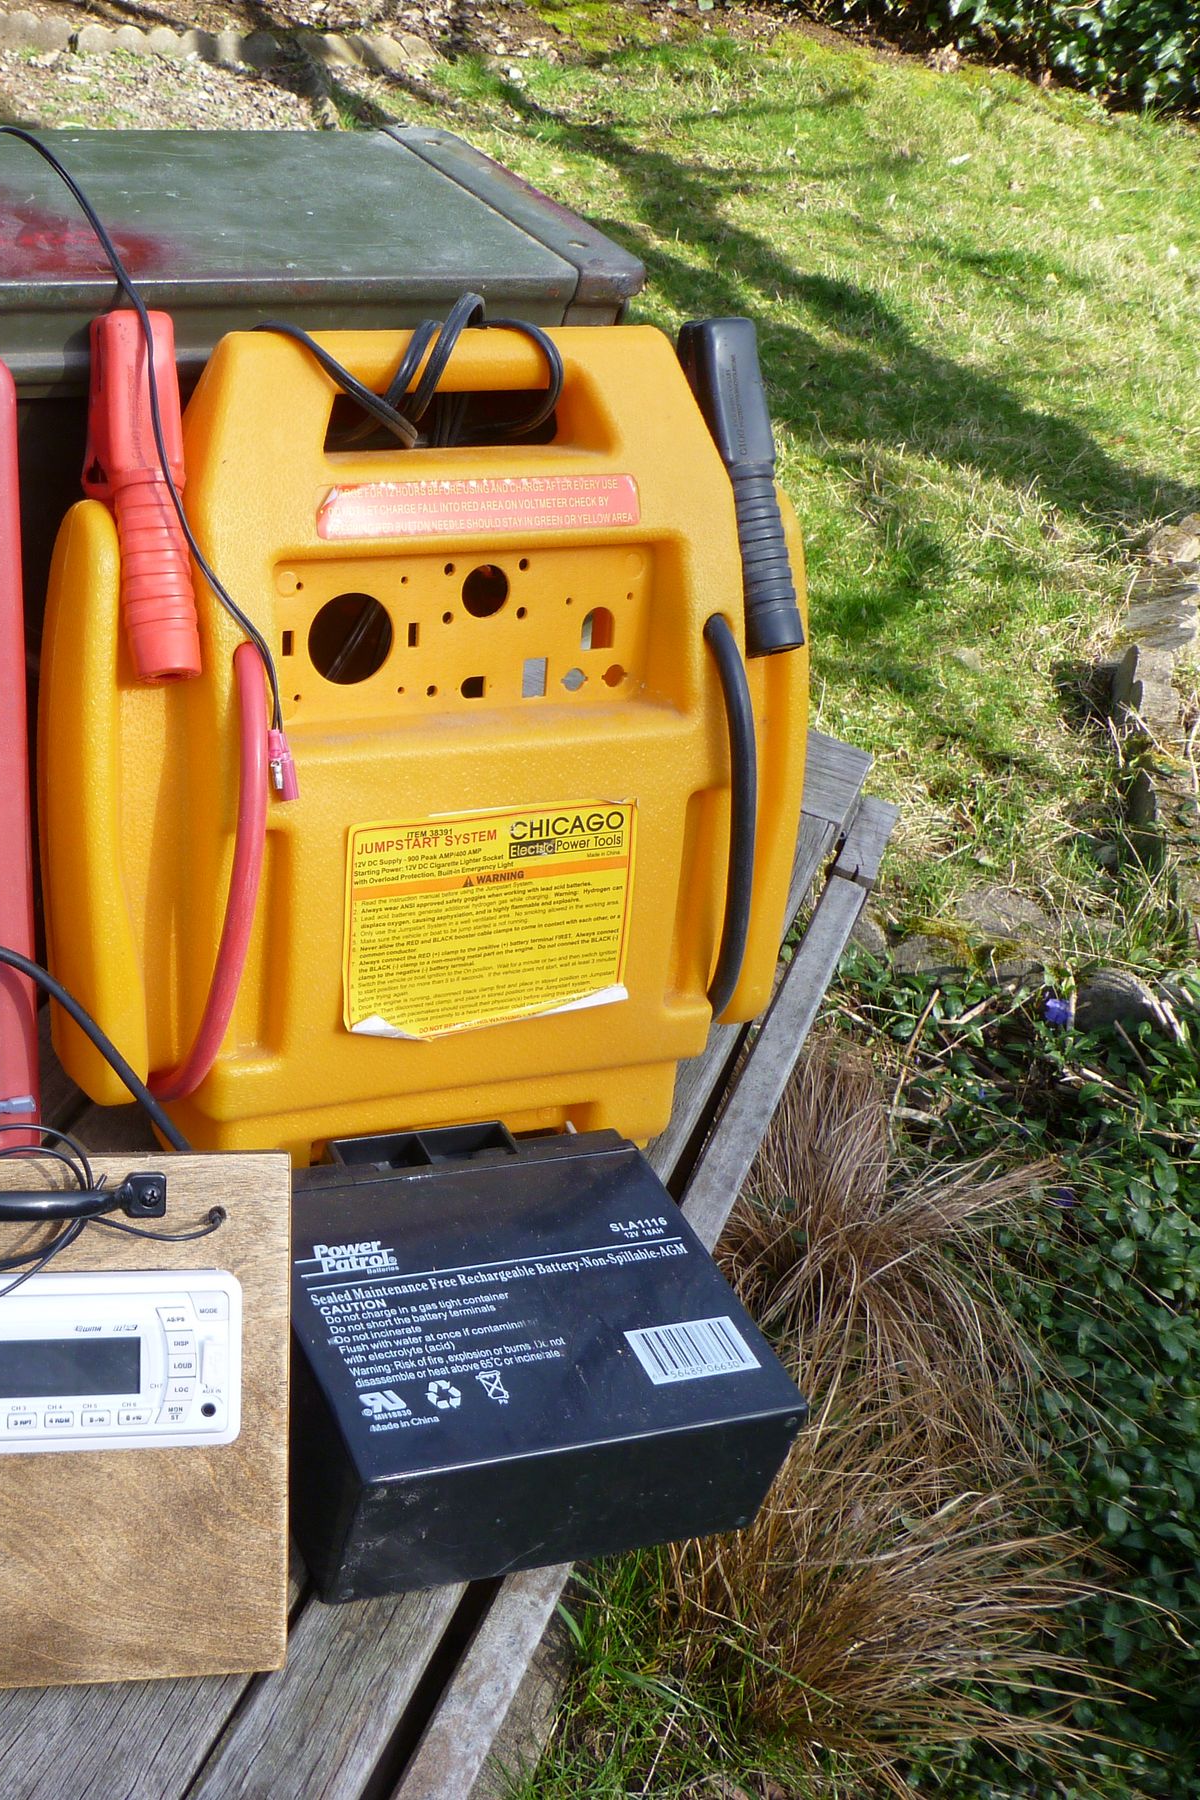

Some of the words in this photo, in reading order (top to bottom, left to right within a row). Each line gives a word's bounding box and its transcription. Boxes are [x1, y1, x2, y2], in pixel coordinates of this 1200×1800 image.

[396, 486, 426, 496] HOURS
[428, 484, 462, 496] BEFORE
[491, 482, 508, 493] AND
[510, 481, 544, 492] CHARGE
[546, 480, 572, 492] AFTER
[574, 480, 600, 490] EVERY
[602, 479, 618, 489] USE
[381, 504, 416, 514] CHARGE
[418, 503, 439, 513] FALL
[440, 502, 460, 512] INTO
[462, 502, 478, 512] RED
[480, 500, 504, 511] AREA
[505, 500, 518, 510] ON
[520, 498, 568, 510] VOLTMETER
[569, 497, 596, 508] CHECK
[598, 496, 609, 507] BY
[434, 520, 464, 530] NEEDLE
[466, 518, 501, 530] SHOULD
[502, 517, 523, 528] STAY
[535, 515, 564, 526] GREEN
[566, 514, 576, 525] OR
[578, 513, 610, 524] YELLOW
[612, 512, 633, 522] AREA
[407, 830, 427, 839] ITEM
[429, 828, 453, 837] 38391
[510, 811, 624, 840] CHICAGO
[357, 836, 440, 855] JUMPSTART
[444, 830, 497, 846] SYSTEM
[556, 838, 590, 850] Power
[594, 834, 621, 846] Tools
[354, 861, 367, 869] 12V
[380, 857, 402, 867] Supply
[421, 853, 436, 861] Peak
[354, 868, 380, 878] Starting
[430, 860, 459, 870] Cigarette
[460, 857, 481, 866] Lighter
[369, 875, 398, 885] Overload
[438, 868, 460, 877] Built-in
[462, 864, 496, 875] Emergency
[476, 870, 525, 885] WARNING
[610, 1216, 668, 1232] SLA1116
[624, 1230, 638, 1238] 12V
[642, 1227, 664, 1236] 18AH
[313, 1240, 381, 1260] Power
[321, 1250, 389, 1273] Patrol
[311, 1290, 352, 1306] Sealed
[352, 1280, 428, 1301] Maintenance
[428, 1275, 458, 1290] Free
[458, 1265, 535, 1286] Rechargeable
[535, 1244, 688, 1274] Battery-Non-Spillable-AGM
[320, 1299, 387, 1316] CAUTION
[325, 1315, 339, 1325] Do
[343, 1313, 360, 1323] not
[362, 1308, 396, 1320] charge
[400, 1306, 408, 1315] in
[420, 1304, 437, 1313] gas
[439, 1298, 461, 1311] tight
[463, 1293, 508, 1306] container
[330, 1325, 347, 1335] Do
[349, 1322, 366, 1332] not
[367, 1318, 393, 1329] short
[395, 1316, 410, 1326] the
[412, 1311, 448, 1324] battery
[449, 1304, 496, 1318] terminals
[335, 1335, 350, 1344] Do
[352, 1332, 370, 1342] not
[370, 1325, 422, 1340] incinerate
[339, 1343, 369, 1355] Flush
[370, 1339, 393, 1351] with
[394, 1336, 422, 1347] water
[425, 1334, 436, 1343] at
[437, 1331, 460, 1341] once
[463, 1328, 469, 1337] if
[344, 1353, 366, 1365] with
[368, 1346, 423, 1362] electrolyte
[425, 1340, 456, 1354] (acid)
[418, 1357, 426, 1367] of
[428, 1355, 444, 1366] fire
[494, 1347, 502, 1355] or
[550, 1337, 566, 1347] not
[355, 1371, 416, 1388] disassemble
[417, 1371, 426, 1379] or
[427, 1366, 450, 1377] heat
[451, 1361, 479, 1373] above
[504, 1357, 514, 1365] or
[670, 1366, 702, 1378] 56489
[370, 1421, 399, 1433] Made
[400, 1420, 409, 1428] in
[410, 1415, 440, 1426] China
